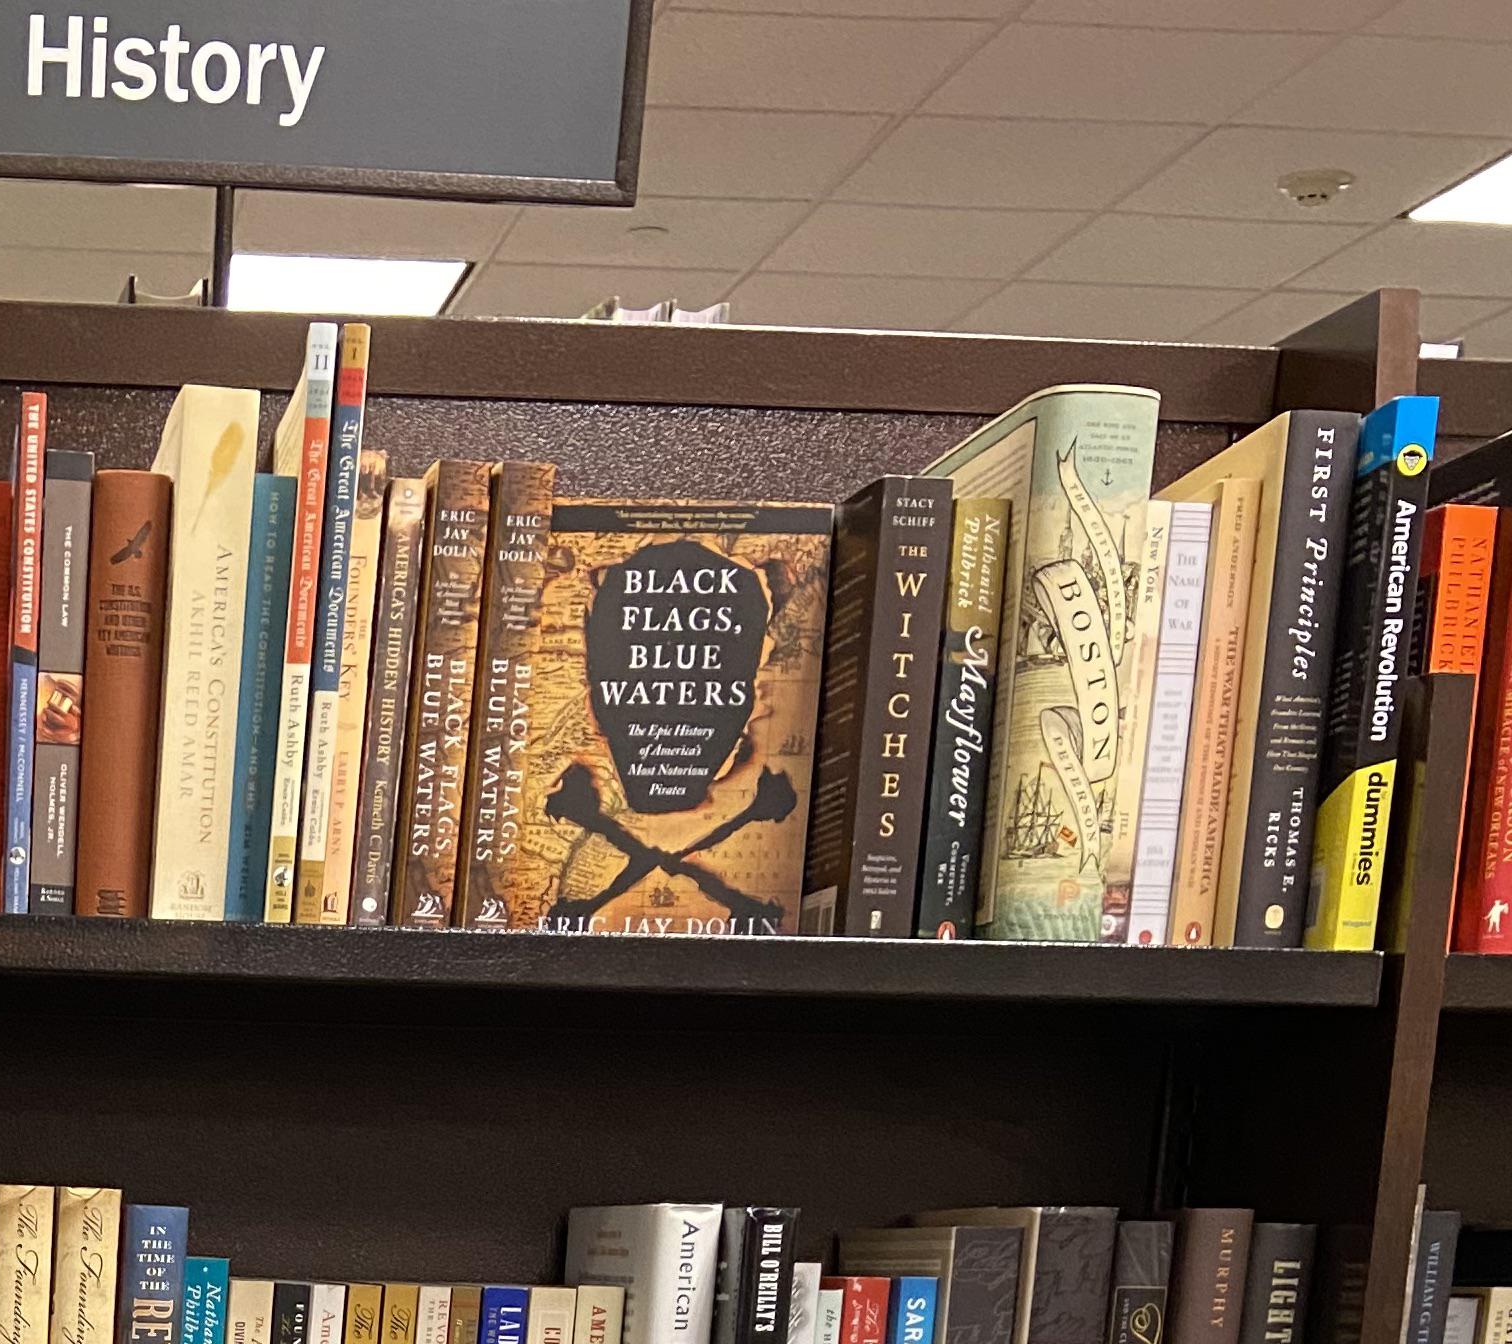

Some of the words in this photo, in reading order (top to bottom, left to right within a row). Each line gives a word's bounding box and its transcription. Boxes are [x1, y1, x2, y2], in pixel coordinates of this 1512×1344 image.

[28, 13, 324, 127] History
[893, 515, 935, 527] SCHIFF
[896, 498, 934, 509] STACY
[1308, 427, 1335, 522] FIRST
[624, 569, 738, 595] BLACK
[899, 546, 928, 557] THE
[1388, 500, 1418, 612] American
[622, 607, 743, 634] FLAGS,
[629, 645, 722, 669] BLUE
[1289, 539, 1329, 680] Principles
[600, 681, 747, 706] WATERS
[879, 572, 927, 837] WITCHES
[1058, 579, 1111, 763] BOSTON
[1369, 613, 1404, 743] Revolution
[946, 625, 988, 829] Mayflower
[1355, 771, 1389, 886] dummies
[676, 1220, 700, 1331] American
